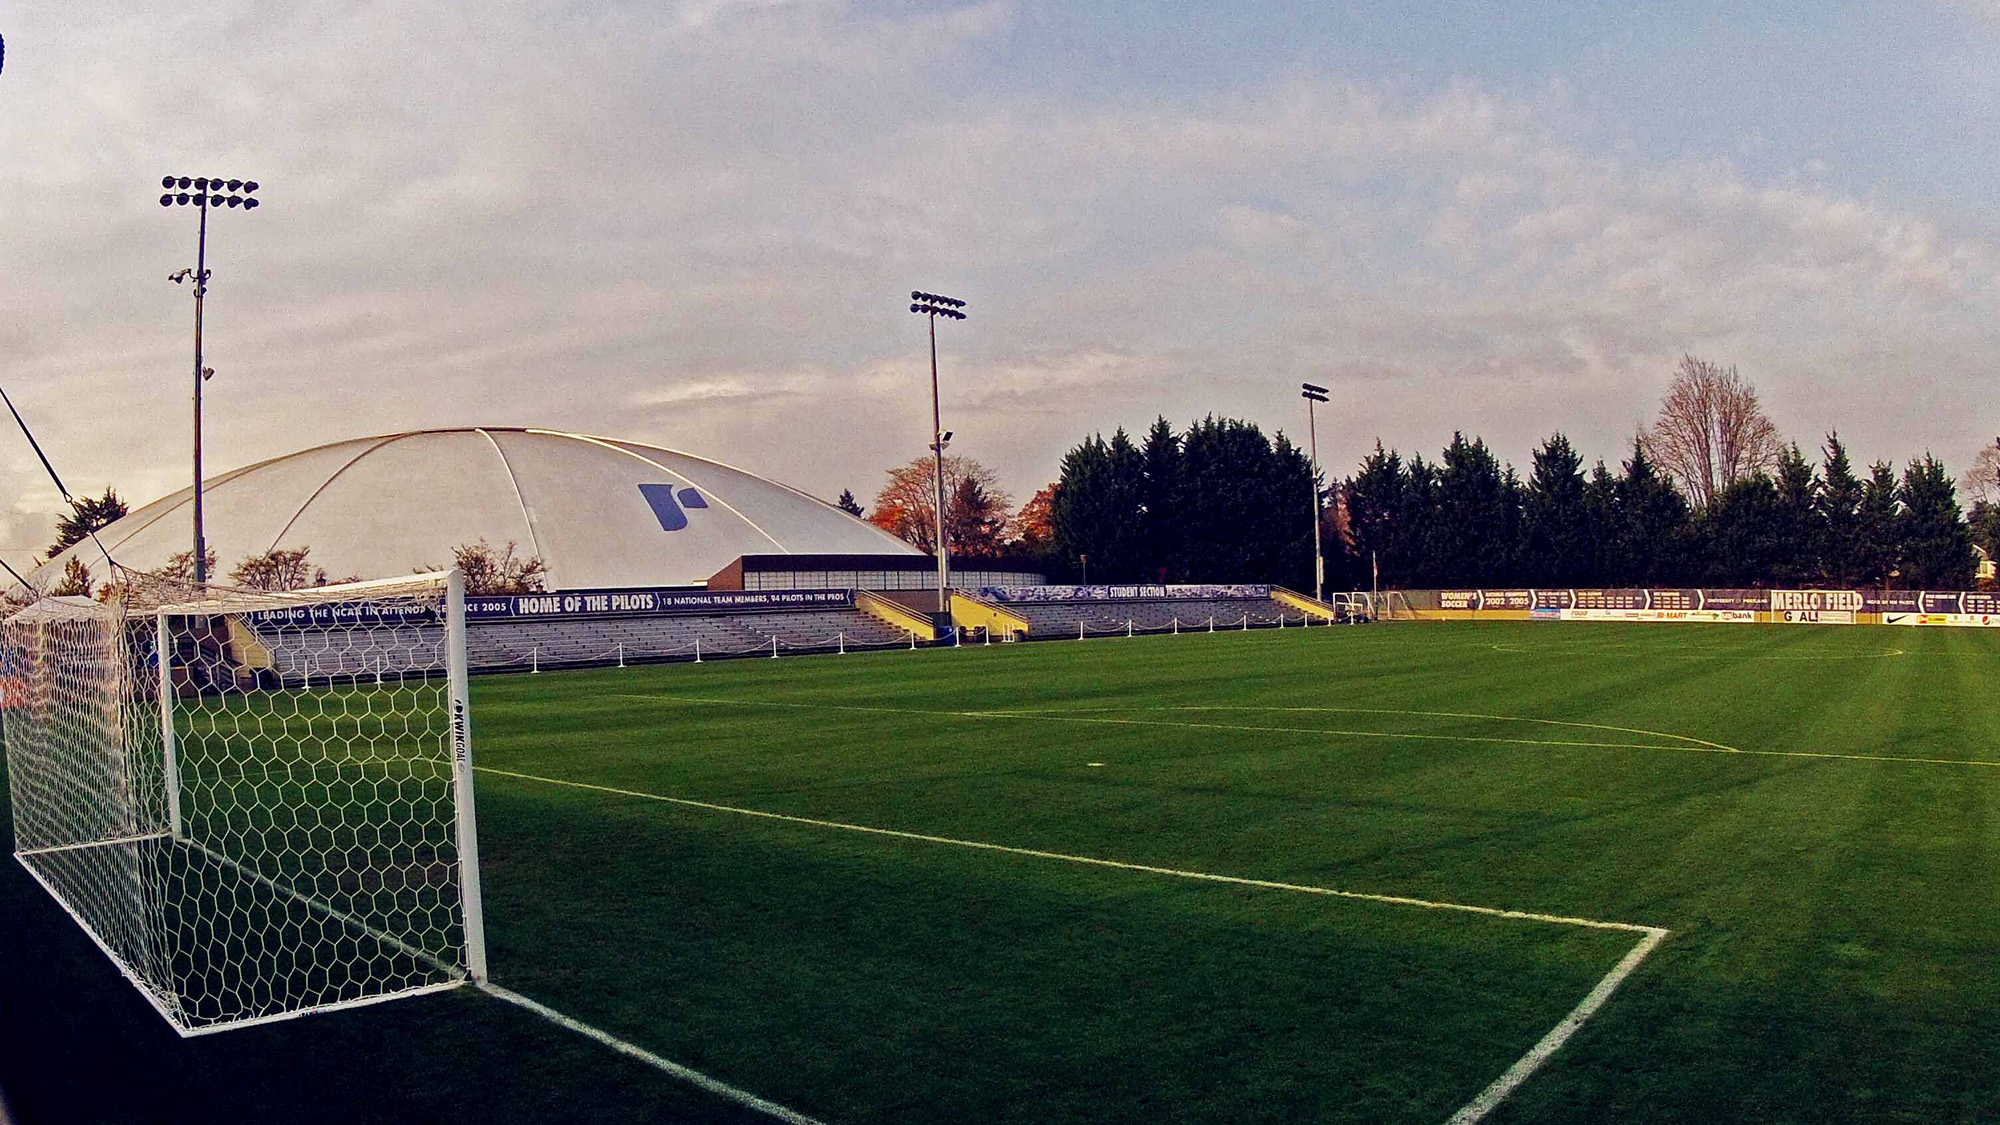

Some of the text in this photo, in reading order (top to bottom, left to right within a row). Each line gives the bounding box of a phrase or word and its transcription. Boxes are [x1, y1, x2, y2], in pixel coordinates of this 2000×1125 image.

[1111, 587, 1165, 598] STUDENT SECTION
[1441, 592, 1477, 601] WOMEN'S
[519, 594, 653, 614] HOME OF THE PILOTS
[662, 597, 672, 606] 18
[674, 596, 712, 606] NATIONAL
[713, 596, 733, 605] TEAM
[782, 594, 804, 602] PILOTS
[804, 593, 814, 602] IN
[814, 593, 826, 601] THE
[827, 593, 844, 601] PROS
[1441, 600, 1468, 608] SOCCER
[1485, 597, 1505, 605] 2002
[1773, 592, 1864, 611] MERLO FIELD
[258, 609, 306, 620] LEADING
[309, 608, 328, 618] THE
[332, 607, 362, 617] NCAA
[365, 606, 378, 616] IN
[482, 603, 506, 612] 2005
